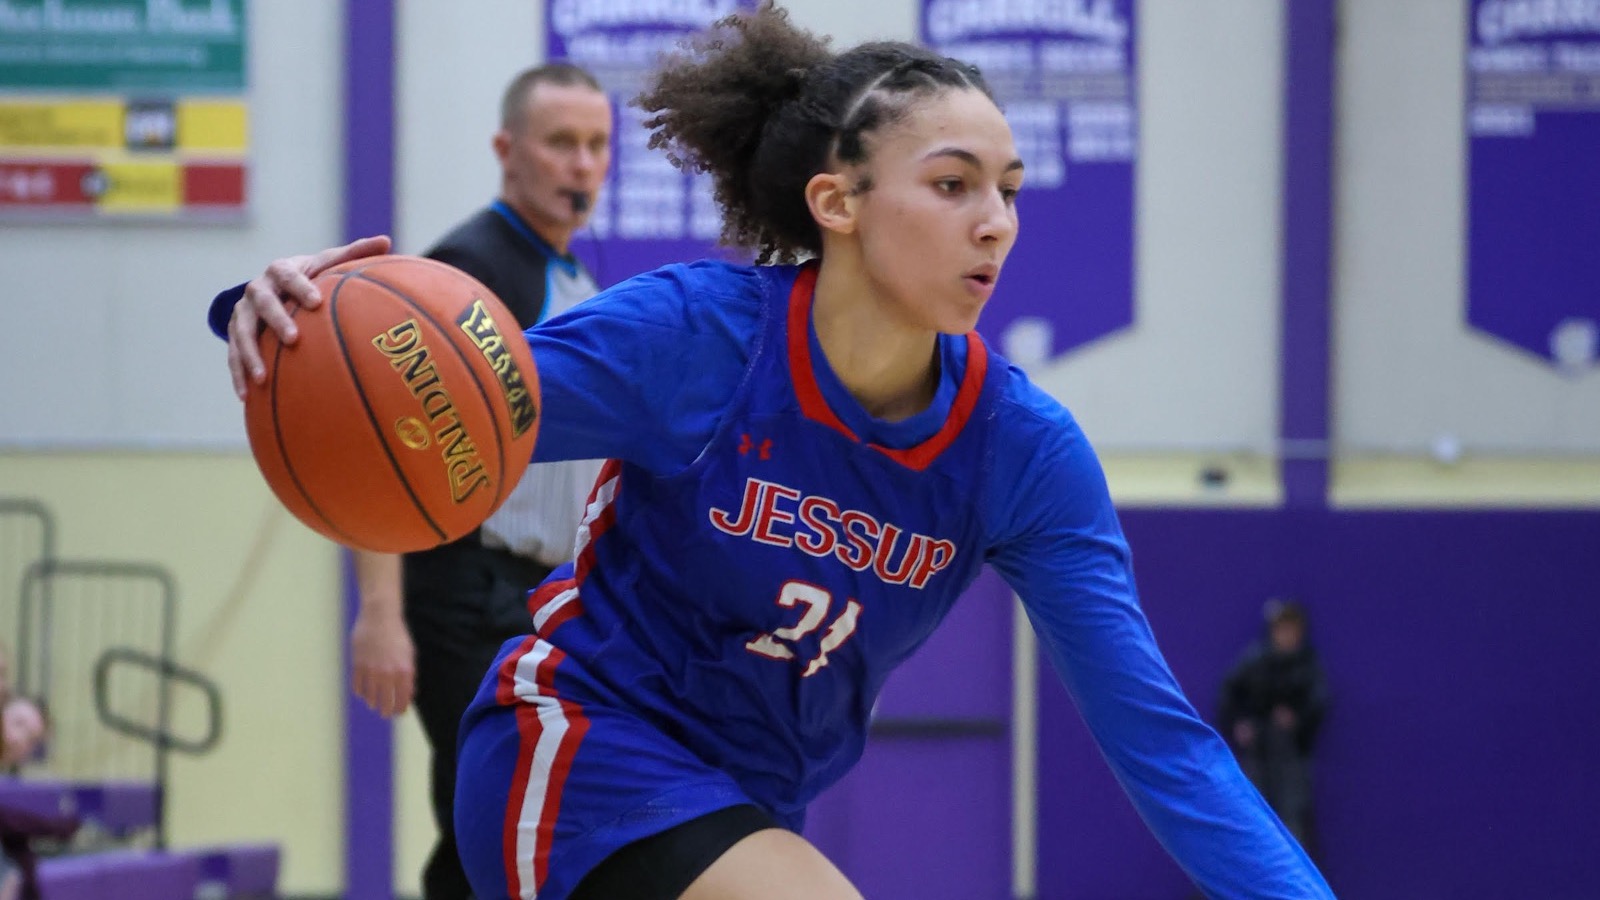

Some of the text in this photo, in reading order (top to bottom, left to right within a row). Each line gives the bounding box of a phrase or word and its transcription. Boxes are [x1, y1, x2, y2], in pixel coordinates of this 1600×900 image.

[371, 319, 490, 503] SPALDING
[461, 300, 536, 437] NAIA
[709, 477, 956, 589] JESSUP
[745, 579, 863, 677] 21
